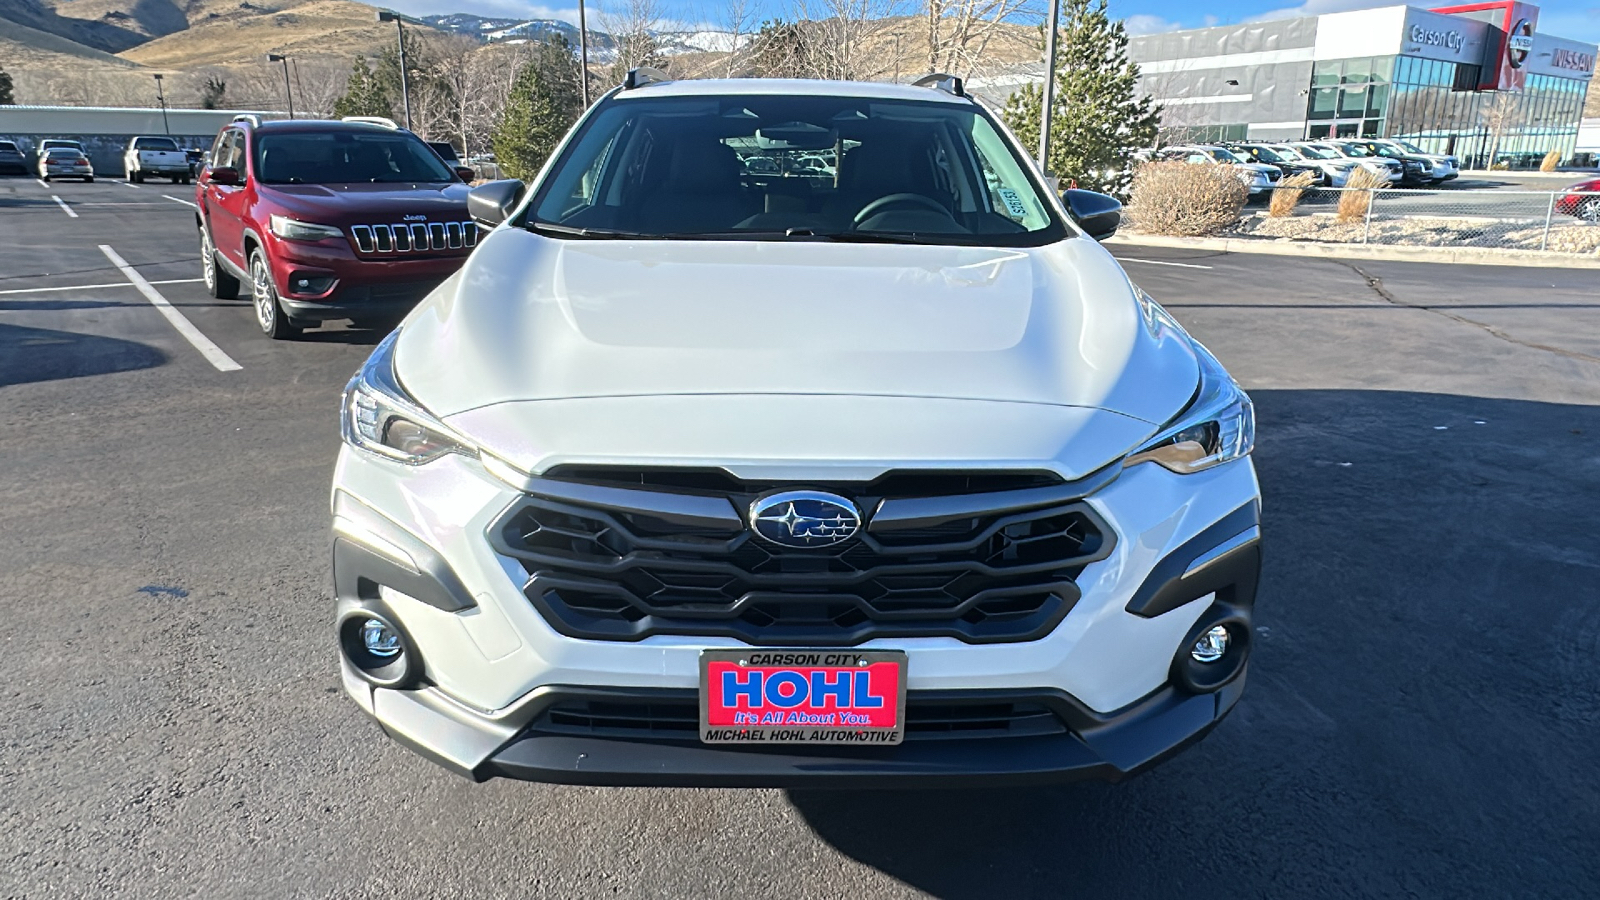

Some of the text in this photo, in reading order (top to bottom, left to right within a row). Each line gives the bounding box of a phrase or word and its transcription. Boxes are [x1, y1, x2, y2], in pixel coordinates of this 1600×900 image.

[1411, 24, 1466, 54] Carson City
[1554, 49, 1593, 72] NISSAN
[750, 654, 862, 665] CARSON CITY
[722, 670, 883, 708] HOHL
[734, 711, 871, 724] It's All About You.
[705, 729, 899, 742] MICHAEL HOHL AUTOMOTIVE
